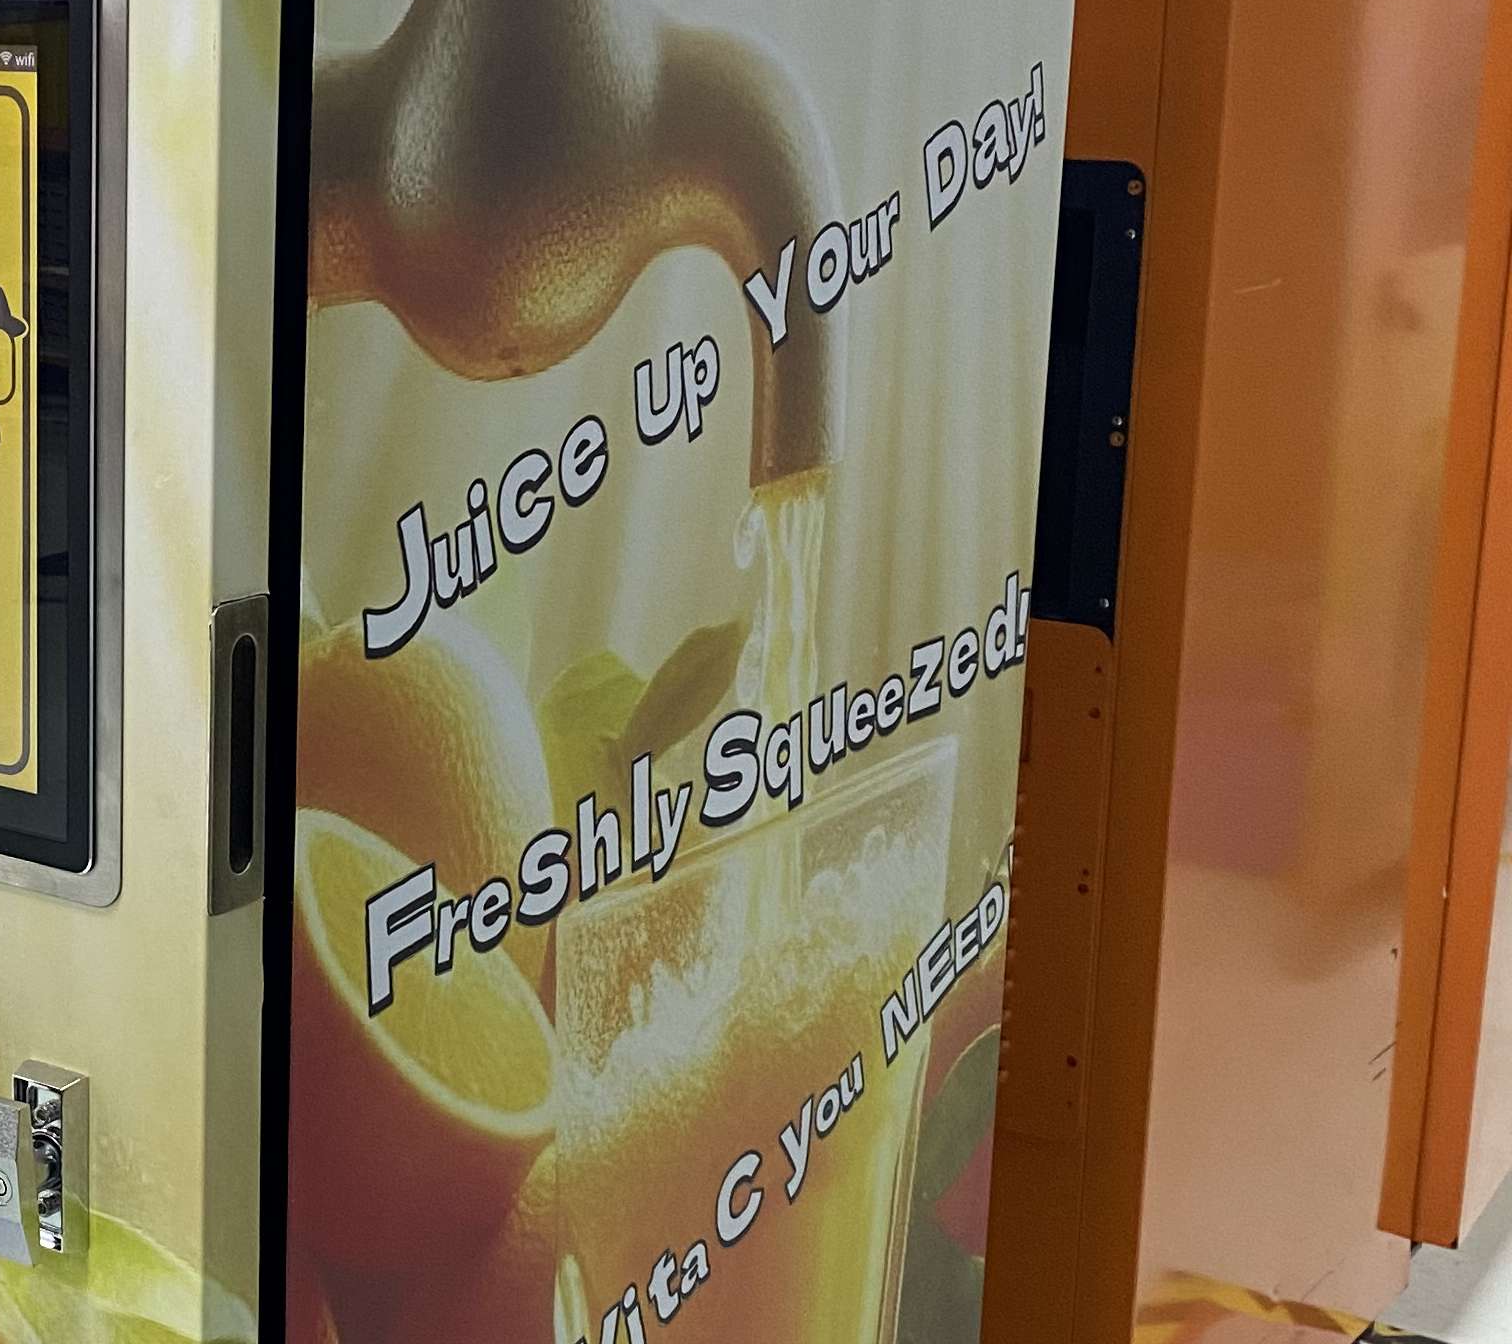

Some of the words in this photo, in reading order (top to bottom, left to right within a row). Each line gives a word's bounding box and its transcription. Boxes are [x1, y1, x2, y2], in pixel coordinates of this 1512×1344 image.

[15, 52, 35, 67] wifi
[635, 335, 720, 443] Up
[922, 61, 1046, 231] Day!
[364, 753, 693, 1018] Freshly
[778, 1051, 865, 1205] you
